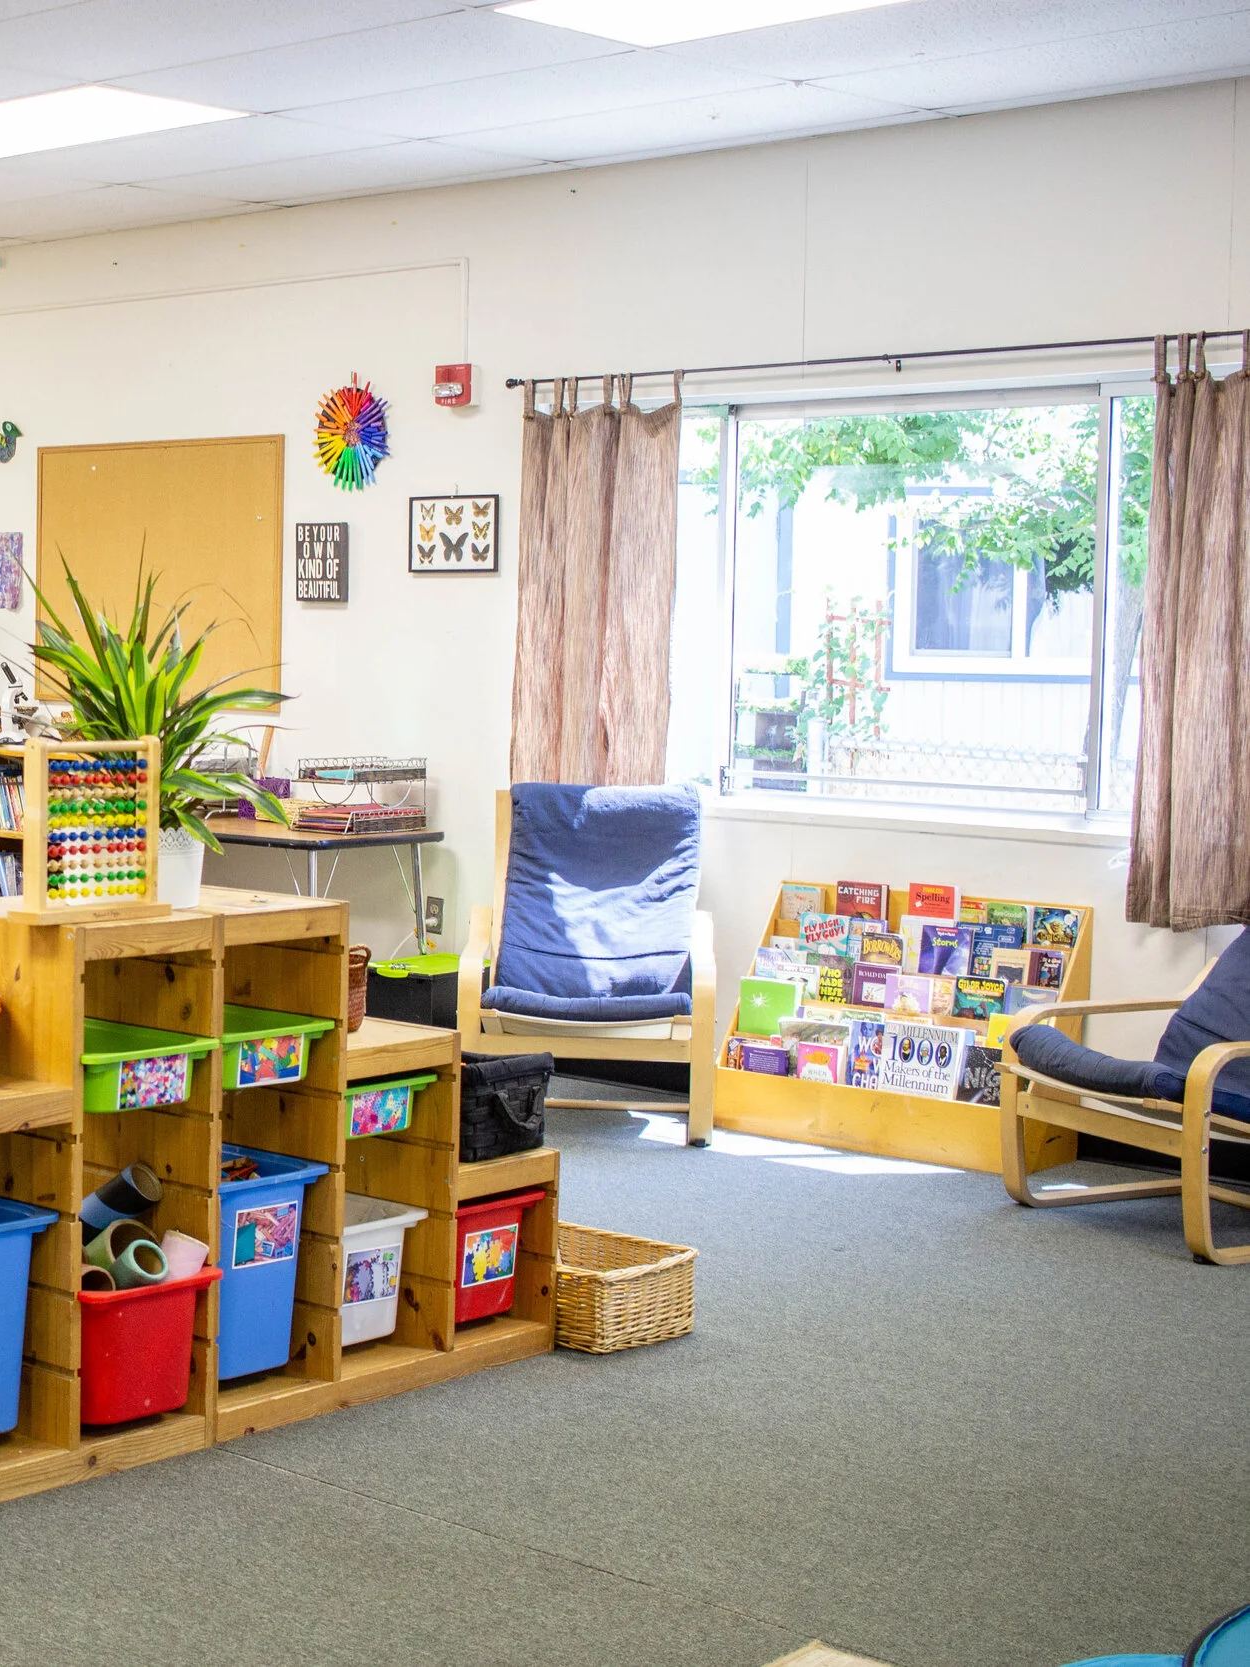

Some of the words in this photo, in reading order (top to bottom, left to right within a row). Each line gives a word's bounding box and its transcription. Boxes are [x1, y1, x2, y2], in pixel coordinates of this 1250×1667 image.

[297, 525, 310, 542] BE
[313, 525, 340, 542] YOUR
[298, 558, 324, 579] KIND
[326, 558, 340, 579] OF
[298, 580, 341, 599] BEAUTIFUL
[837, 886, 880, 897] CATCHING
[915, 892, 950, 904] Spelling
[855, 896, 877, 905] FIRE
[804, 923, 817, 934] FLY
[805, 931, 822, 943] FLY
[822, 926, 845, 940] GUY!
[931, 937, 958, 949] Storms
[819, 966, 841, 979] WHO
[858, 970, 877, 979] ROALD
[820, 986, 842, 996] HESE
[981, 981, 1004, 993] JOYCE
[901, 1025, 959, 1044] MILLENNIUM
[858, 1035, 882, 1057] WO
[888, 1035, 953, 1068] 1000
[884, 1060, 920, 1076] Makers
[921, 1066, 934, 1078] of
[934, 1067, 951, 1081] the
[964, 1066, 1001, 1089] NIG
[852, 1072, 878, 1090] CHA
[882, 1072, 949, 1094] Millennium
